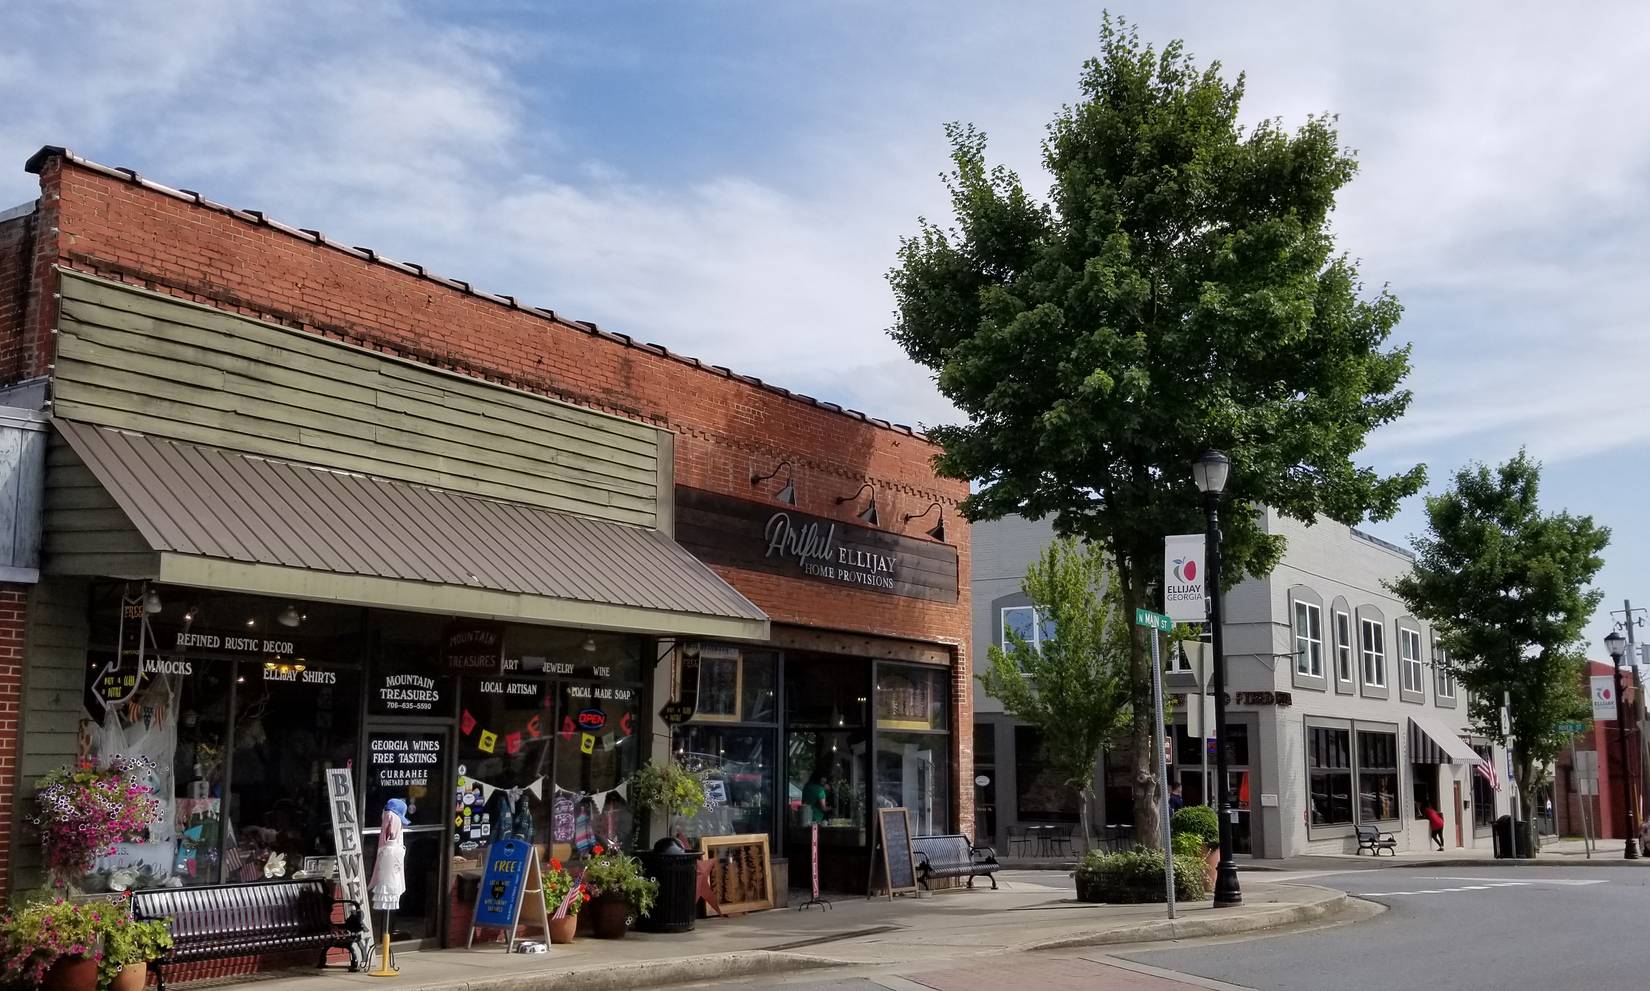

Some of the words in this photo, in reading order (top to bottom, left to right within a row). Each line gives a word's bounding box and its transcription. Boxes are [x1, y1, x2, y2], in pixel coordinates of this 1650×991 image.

[765, 512, 835, 567] Artful
[838, 547, 897, 574] ELLIJAY
[805, 563, 835, 579] HOME
[838, 569, 894, 589] PROVISIONS
[1167, 584, 1201, 593] ELLIJAY
[1167, 593, 1203, 601] GEORGIA
[1138, 613, 1143, 623] N
[1145, 613, 1159, 627] MAIN
[1160, 620, 1168, 629] ST
[176, 632, 220, 648] REFINED
[224, 636, 259, 651] RUSTIC
[263, 640, 294, 654] DECOR
[449, 630, 497, 647] MOUNTAIN
[449, 655, 497, 668] TREASURES
[503, 659, 519, 671] ART
[543, 662, 575, 674] JEWELRY
[302, 670, 337, 684] SHIRTS
[592, 666, 611, 677] WINE
[385, 674, 435, 690] MOUNTAIN
[480, 681, 504, 693] LOCAL
[506, 683, 538, 695] ARTISAN
[380, 688, 440, 702] TREASURES
[571, 686, 592, 698] LOCAL
[594, 687, 613, 699] MADE
[614, 689, 632, 700] SOAP
[578, 713, 605, 724] OPEN
[371, 740, 409, 751] GEORGIA
[412, 740, 440, 751] WINES
[373, 753, 395, 764] FREE
[398, 753, 438, 764] TASTINGS
[380, 769, 428, 779] CURRAHEE
[494, 860, 518, 873] FREE
